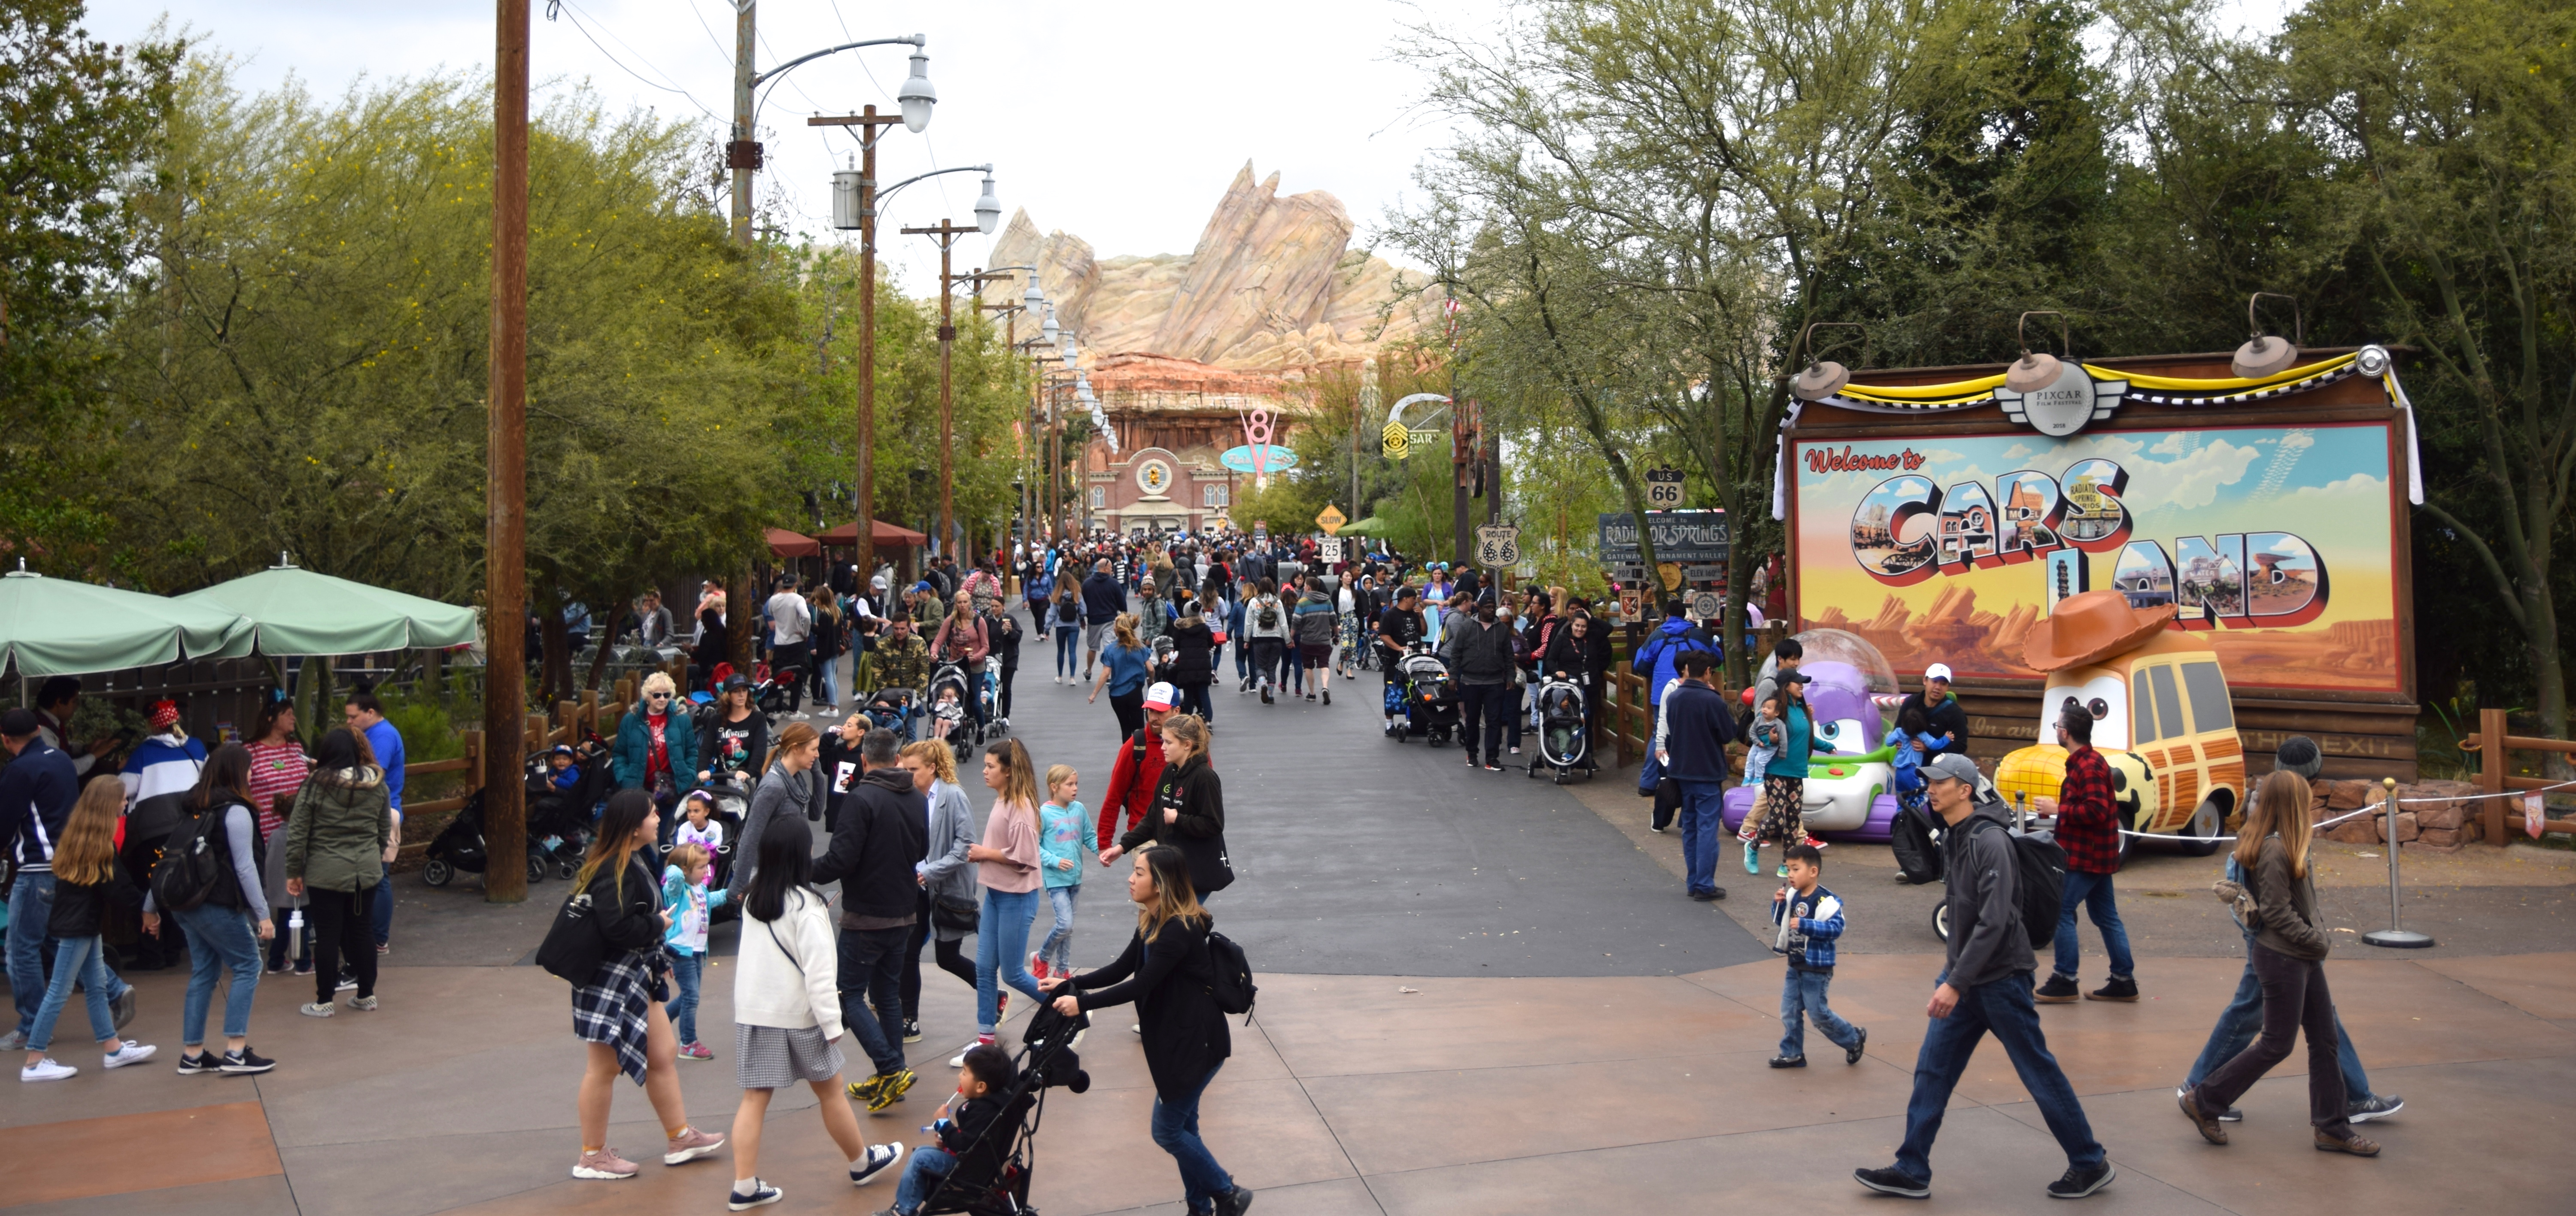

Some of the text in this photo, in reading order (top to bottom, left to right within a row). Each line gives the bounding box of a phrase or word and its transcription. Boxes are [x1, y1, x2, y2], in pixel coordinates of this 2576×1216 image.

[2037, 391, 2081, 400] PIXCAR
[1410, 433, 1432, 444] SAR
[1804, 446, 1926, 473] Welcome to
[1658, 473, 1673, 481] US
[1652, 486, 1677, 501] 66
[1851, 458, 2133, 586] CARS
[2009, 510, 2040, 518] MEL
[1666, 524, 1728, 546] SPRINGS
[1325, 545, 1338, 556] 25
[1483, 540, 1515, 561] 66
[2047, 532, 2330, 630] LAND
[1972, 717, 2000, 736] In
[2242, 732, 2396, 755] THI EXIT
